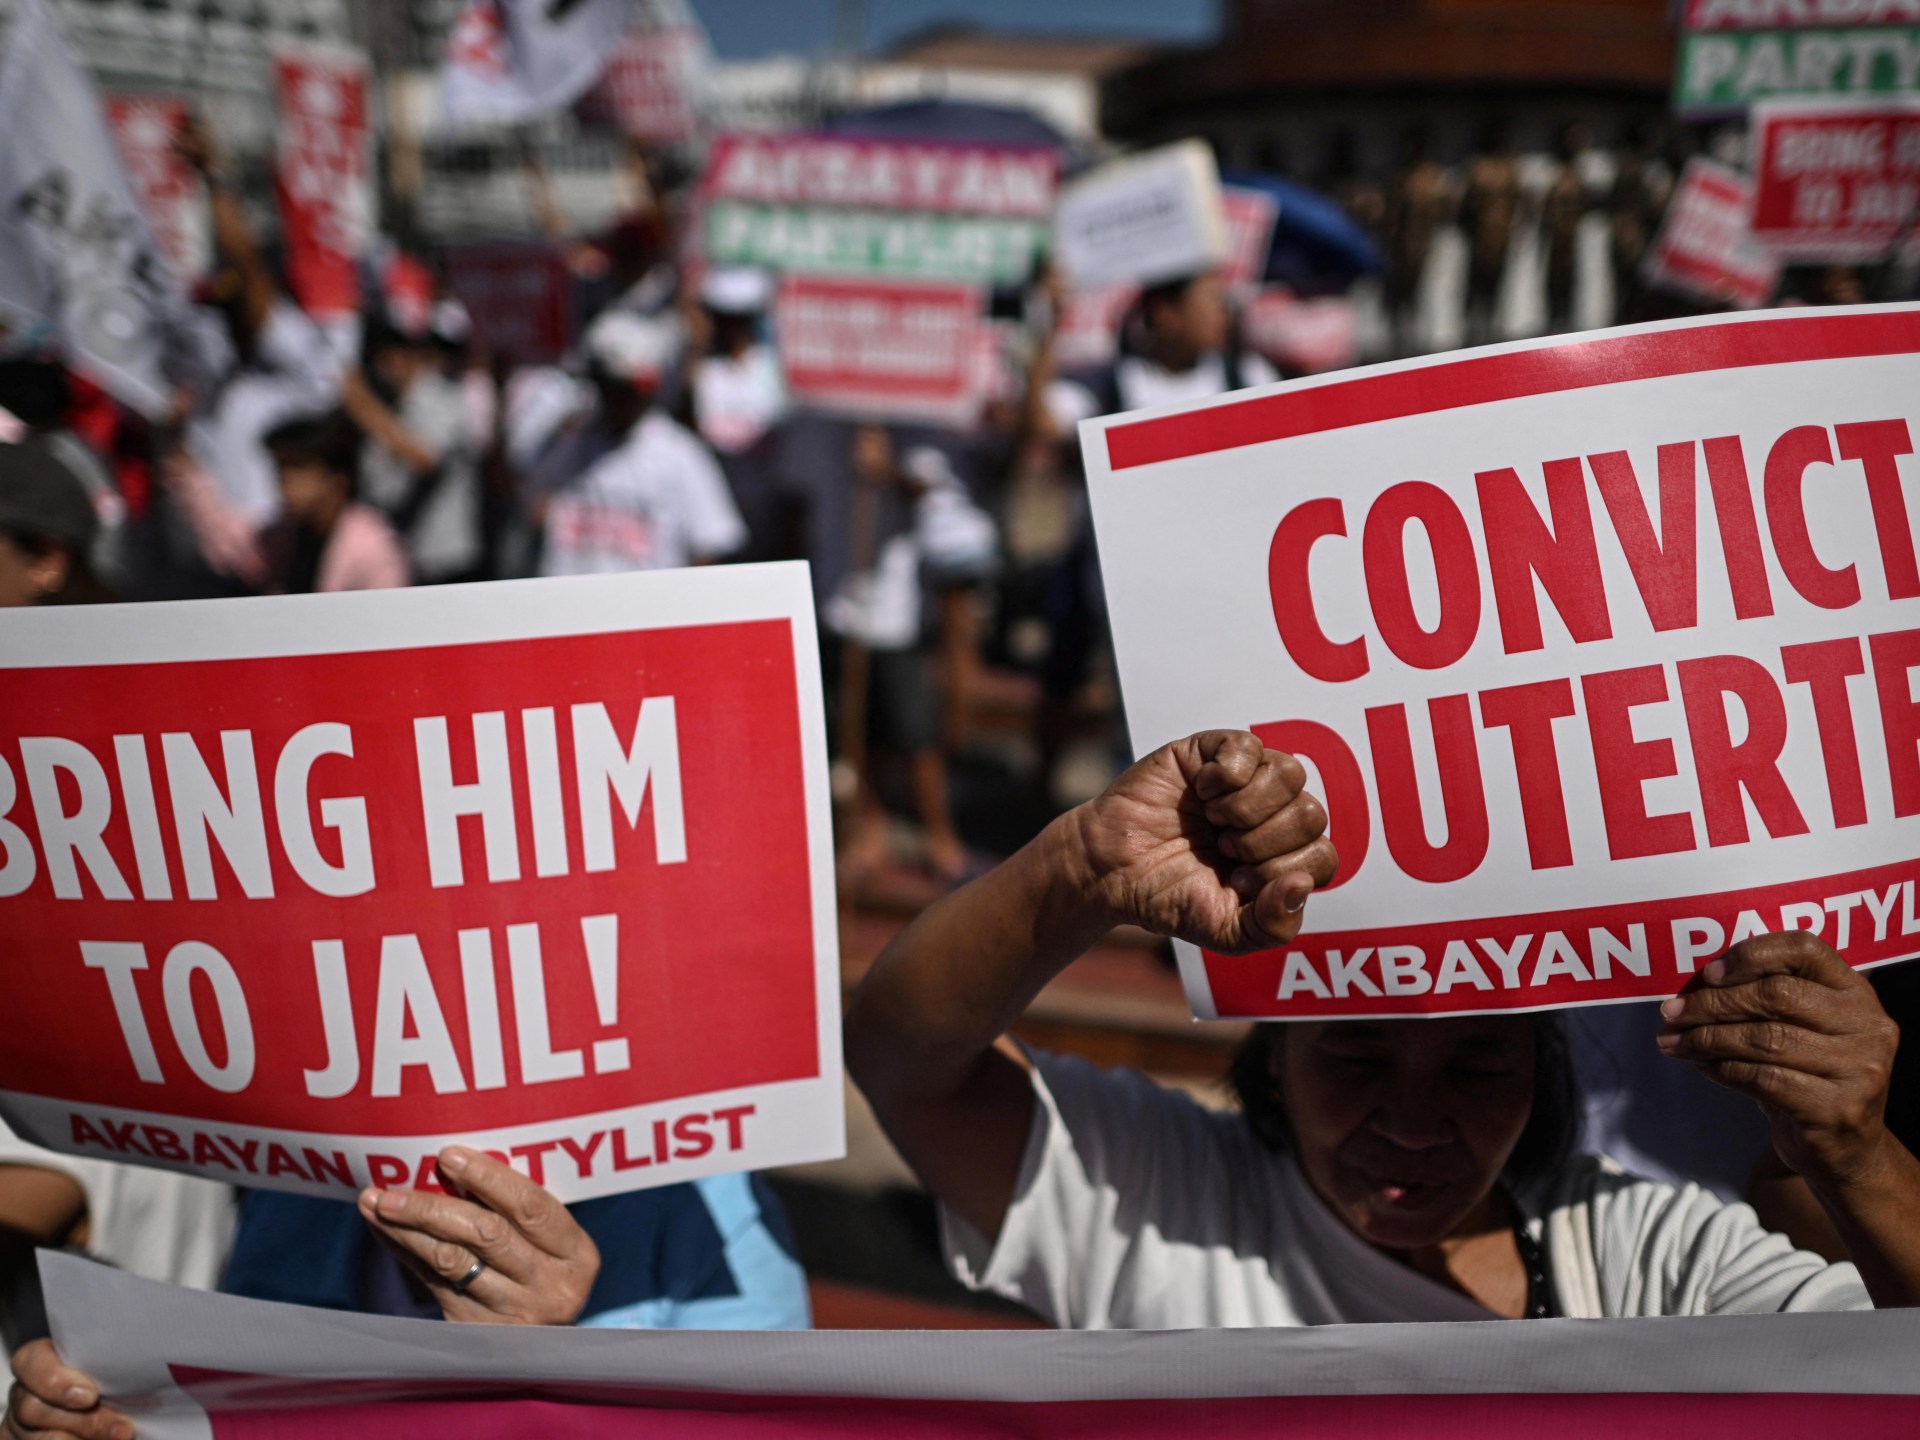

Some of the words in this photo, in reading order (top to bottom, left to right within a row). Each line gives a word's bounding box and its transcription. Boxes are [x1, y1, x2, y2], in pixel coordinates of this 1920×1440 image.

[1267, 417, 1920, 684] CONVICT
[412, 695, 689, 889] HIM
[78, 939, 257, 1095] TO
[303, 913, 631, 1099] JAIL!
[1276, 925, 1652, 1000] AKBAYAN
[69, 1112, 359, 1190] AKBAYAN
[366, 1105, 756, 1196] PATYLIST
